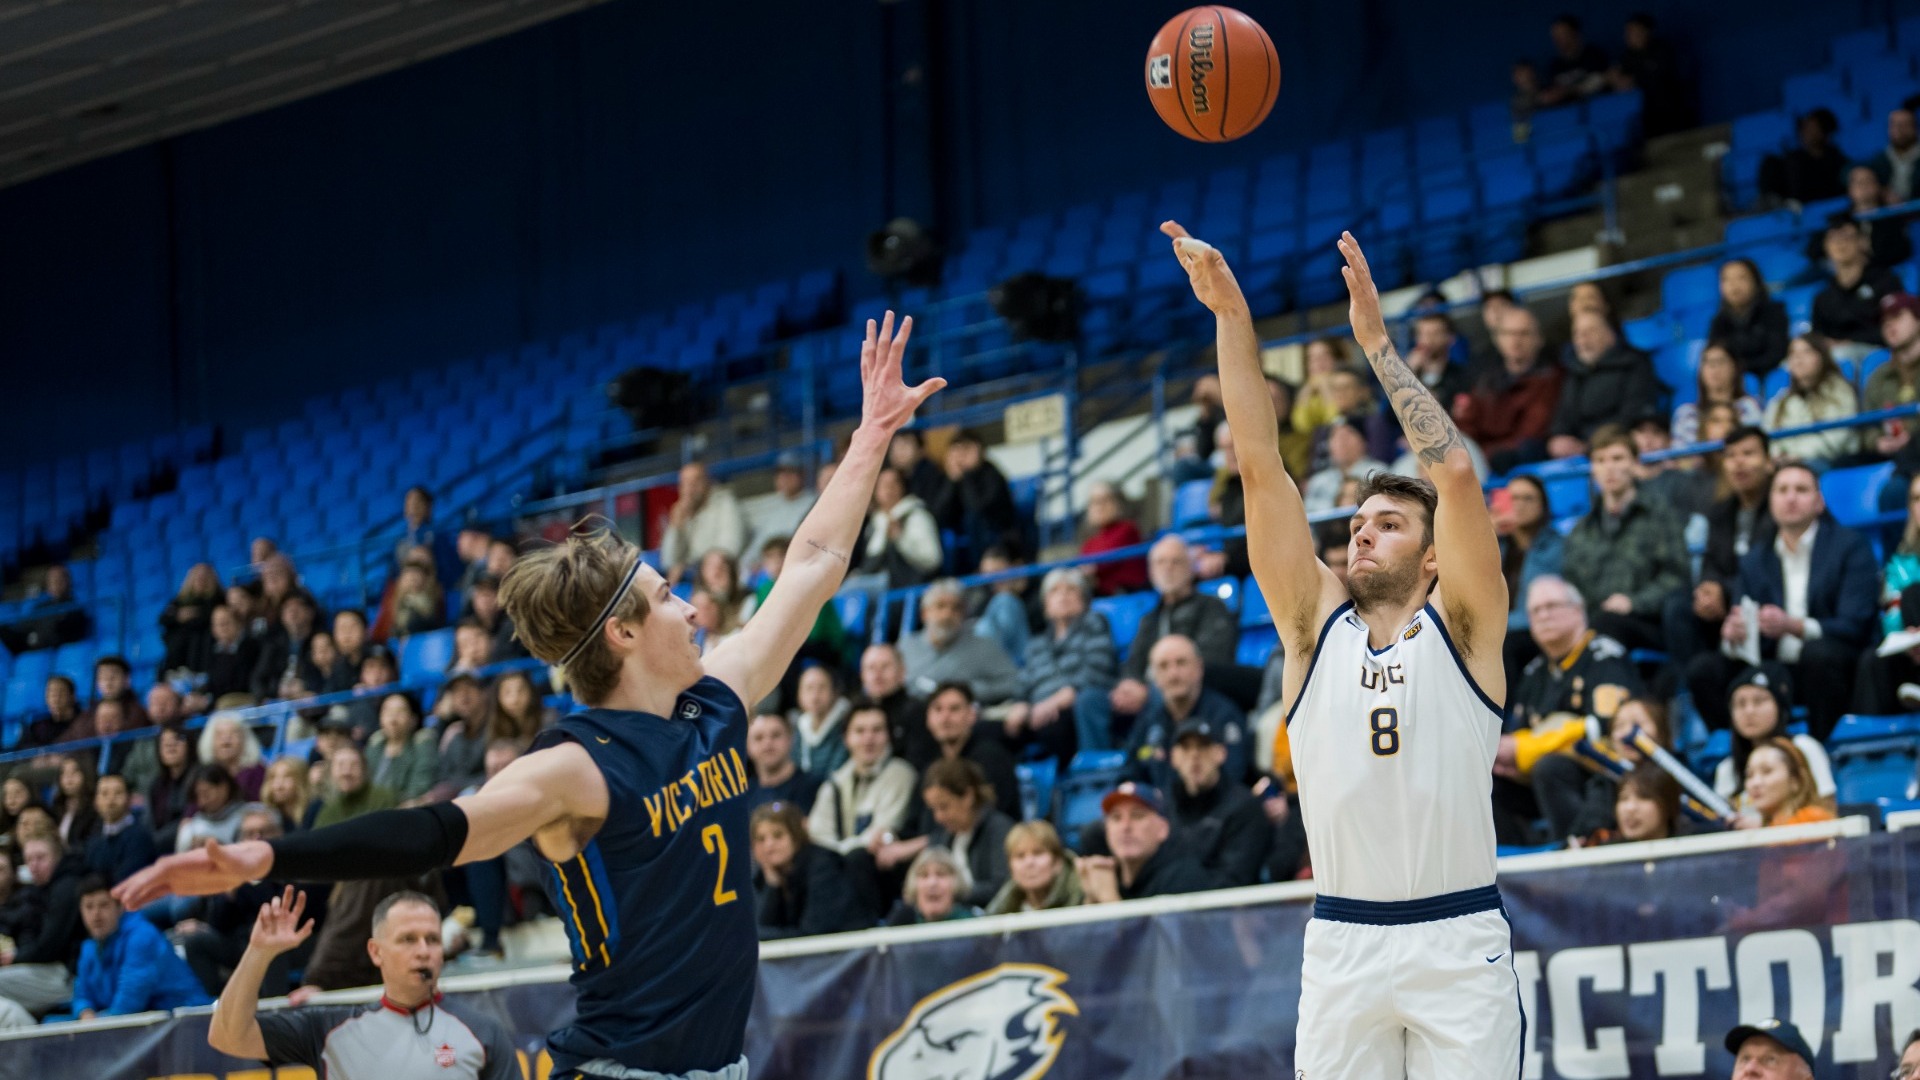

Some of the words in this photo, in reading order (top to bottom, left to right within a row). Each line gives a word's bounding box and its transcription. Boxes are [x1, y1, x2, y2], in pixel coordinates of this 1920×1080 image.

[1190, 23, 1214, 116] Wilson
[1404, 622, 1421, 640] WEST
[1371, 708, 1399, 756] 8
[643, 747, 748, 837] VICTORIA
[702, 823, 737, 906] 2
